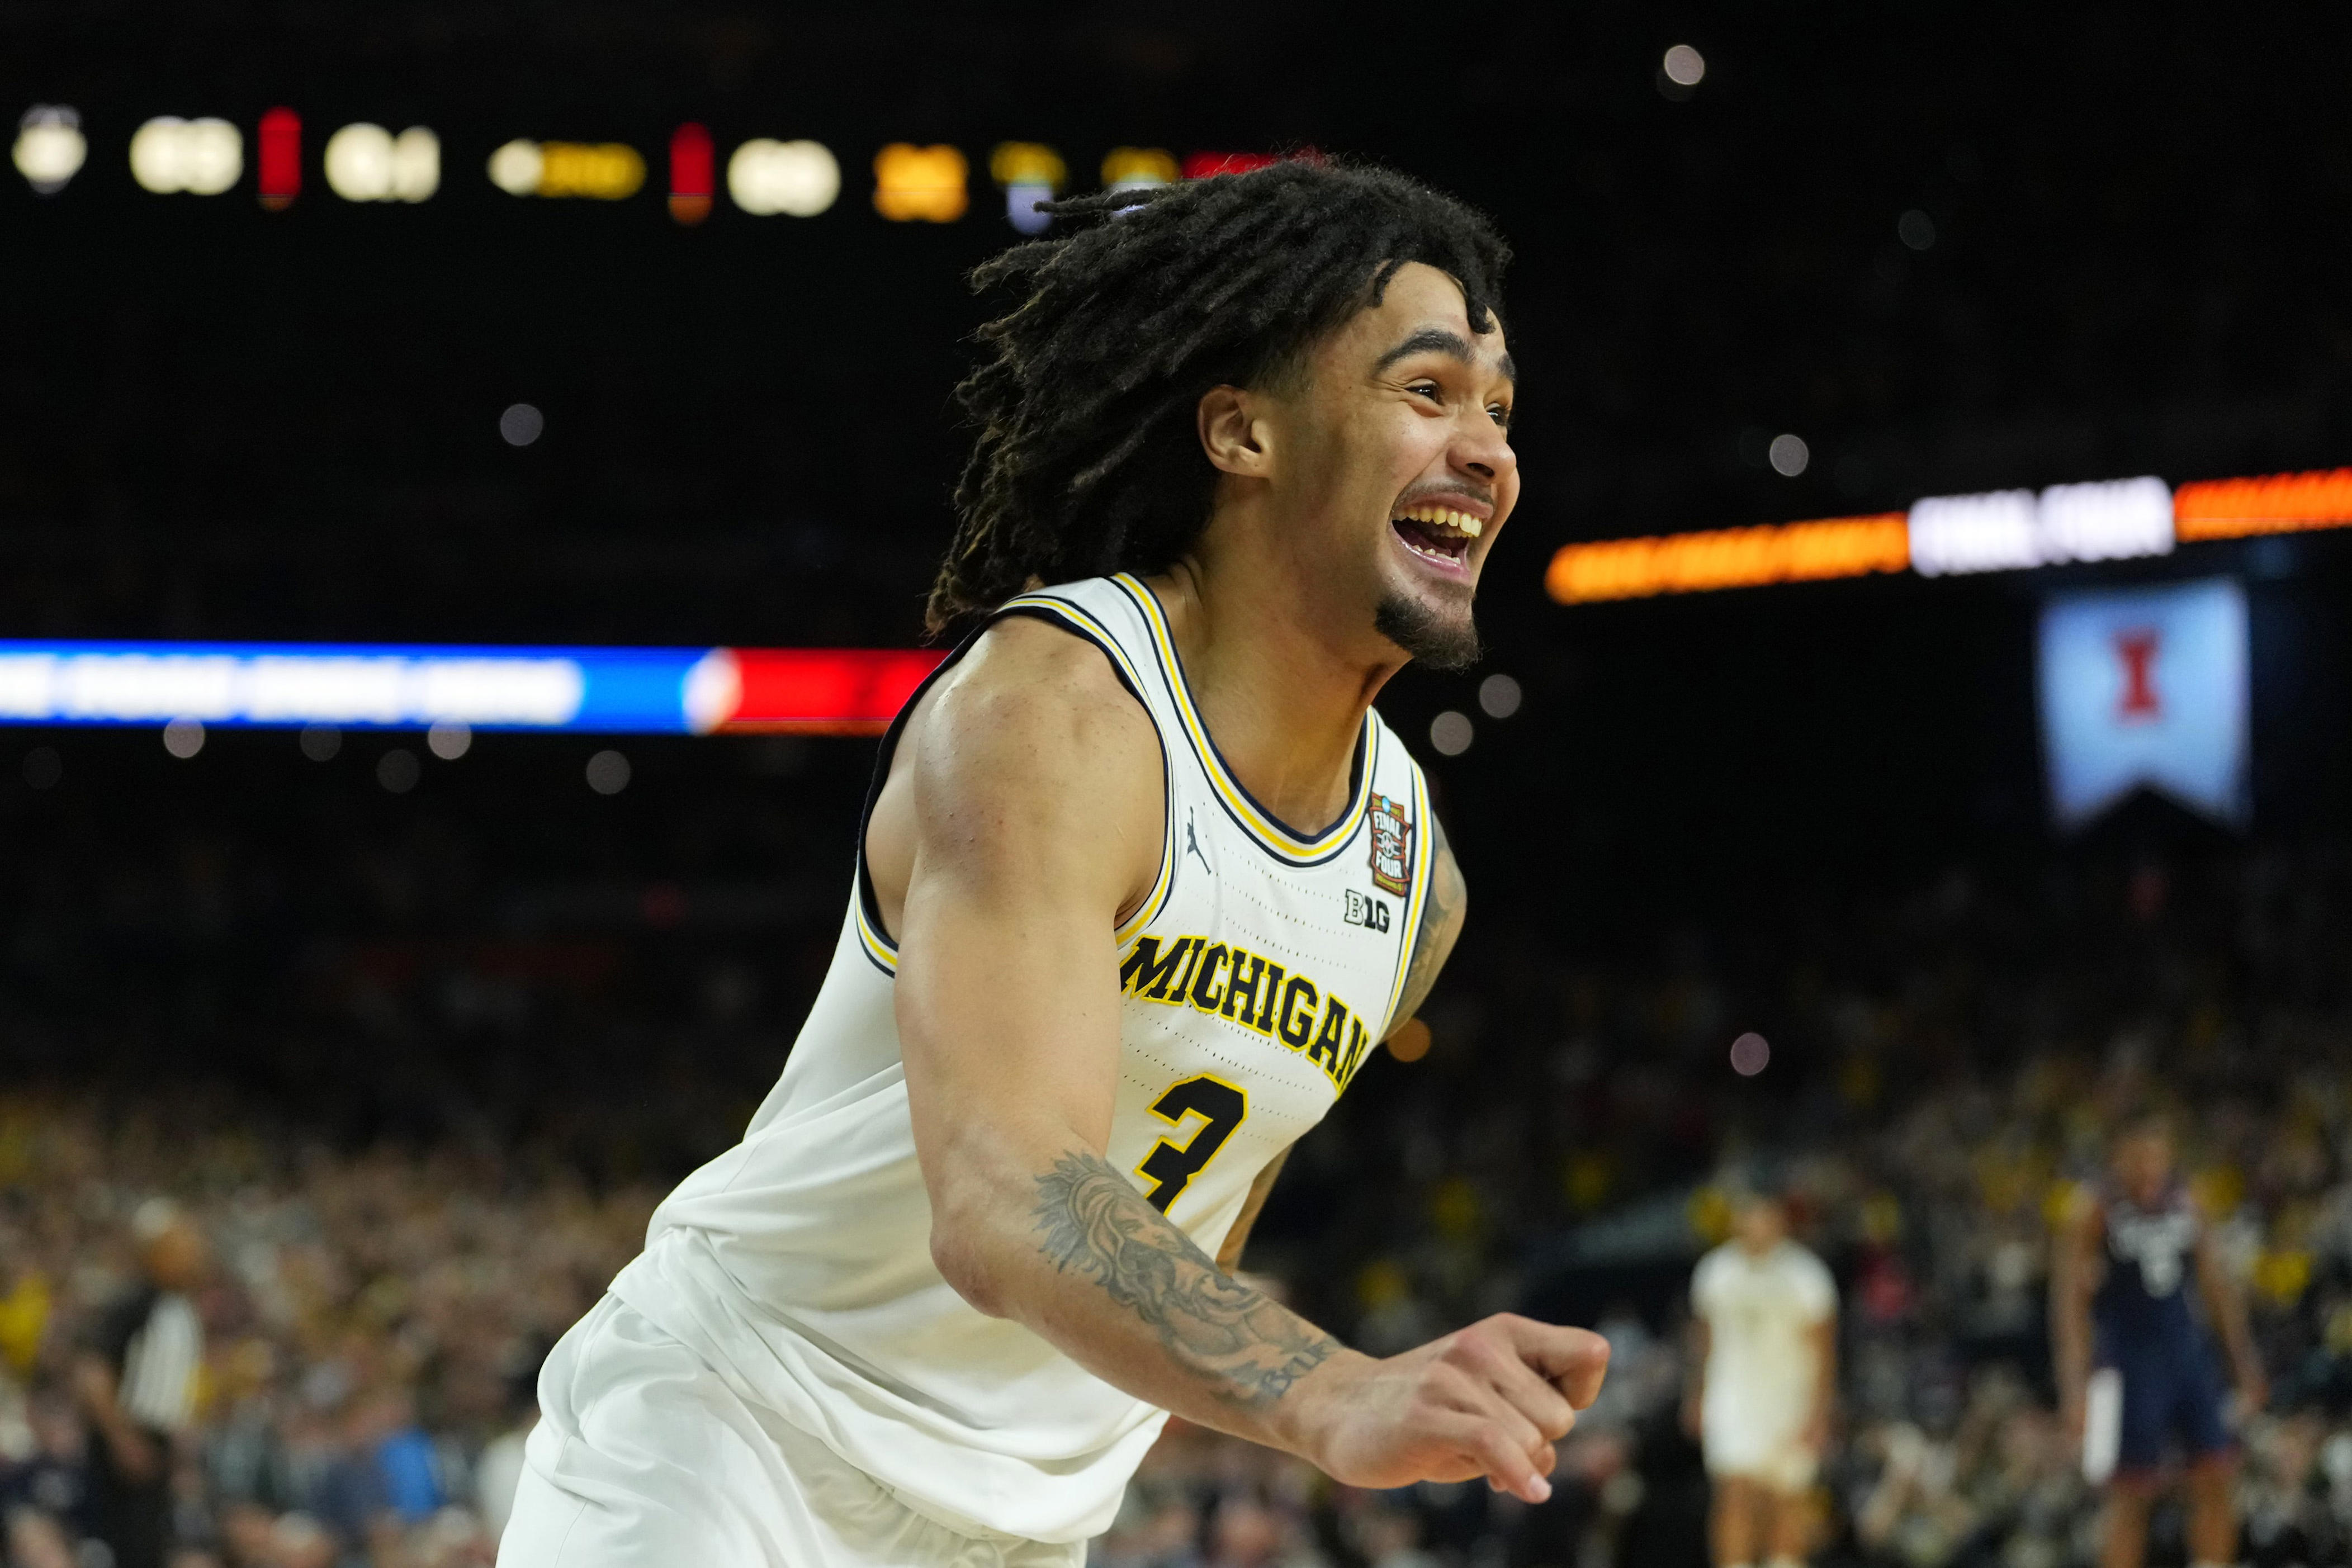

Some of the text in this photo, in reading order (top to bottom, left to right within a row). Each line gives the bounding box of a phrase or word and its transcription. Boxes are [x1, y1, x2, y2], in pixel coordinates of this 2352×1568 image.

[2111, 629, 2162, 721] I
[1373, 811, 1402, 839] FINAL
[1376, 851, 1402, 878] FOUR
[1119, 934, 1371, 1101] MICHIGAN
[1134, 1072, 1248, 1218] 3
